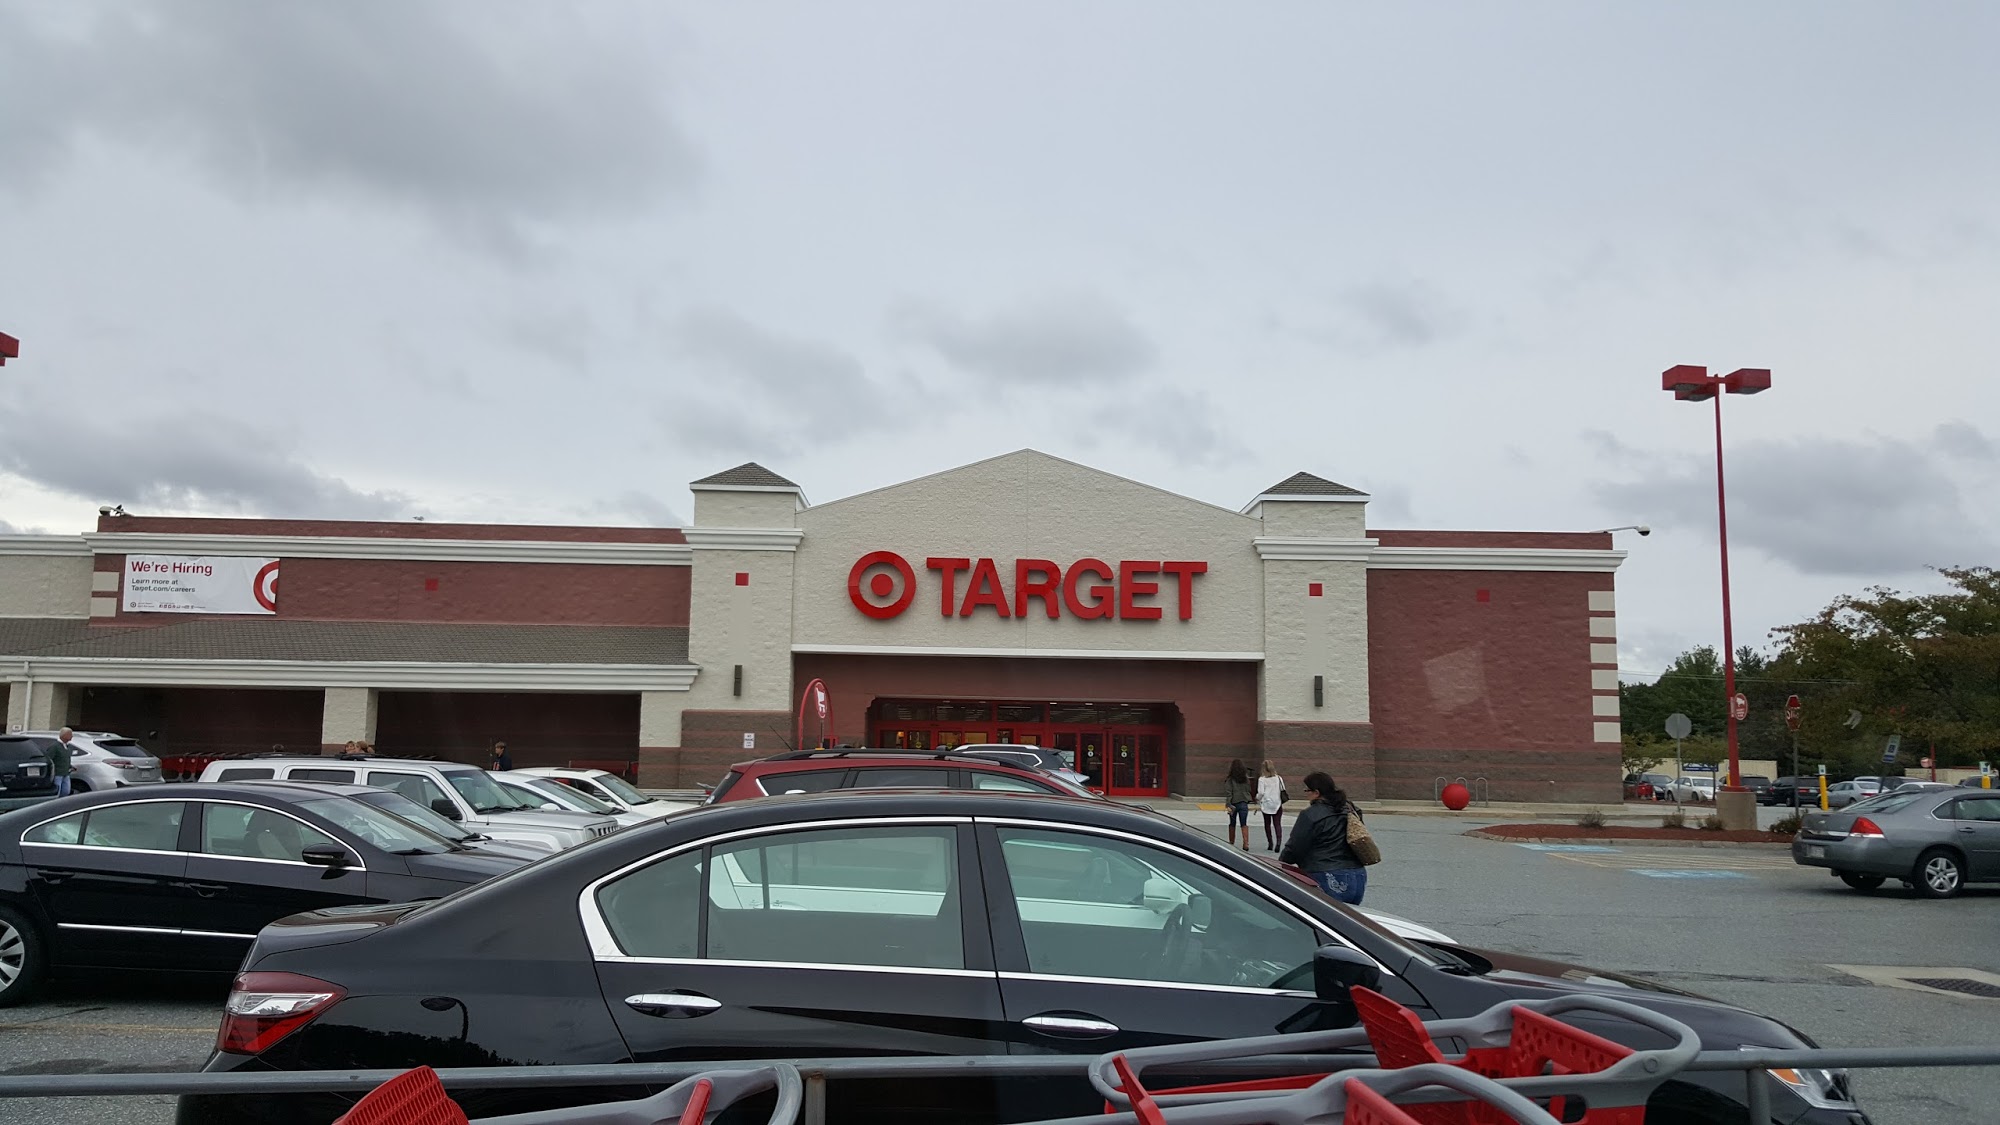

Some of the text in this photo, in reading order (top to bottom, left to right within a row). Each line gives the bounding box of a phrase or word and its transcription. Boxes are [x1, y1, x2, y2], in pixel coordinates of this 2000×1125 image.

[131, 561, 213, 577] We're Hiring
[131, 585, 196, 593] Target.com/careers
[926, 556, 1208, 620] TARGET
